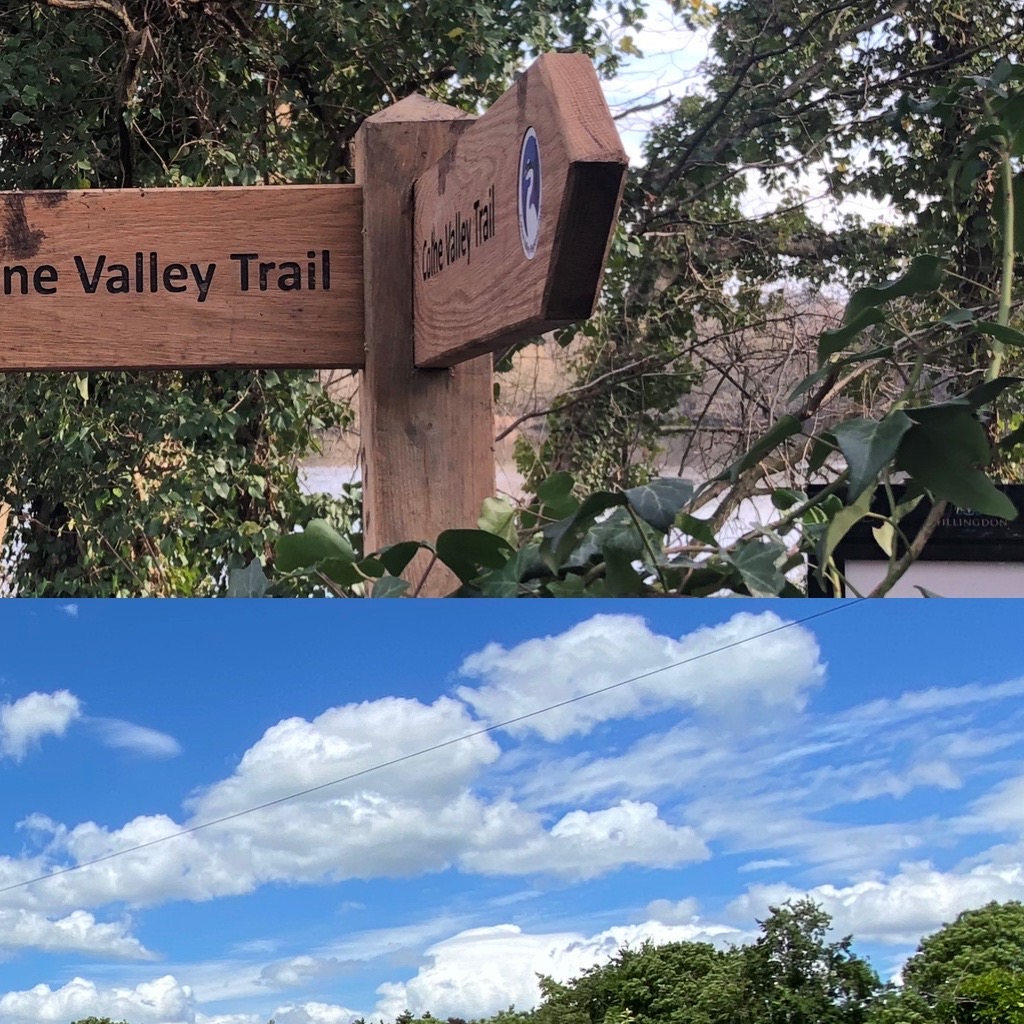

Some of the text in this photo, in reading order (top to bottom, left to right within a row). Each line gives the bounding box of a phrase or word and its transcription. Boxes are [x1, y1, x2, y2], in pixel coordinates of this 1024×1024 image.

[445, 211, 471, 266] Valley
[474, 184, 495, 248] Trail
[74, 251, 217, 303] Valley
[230, 248, 331, 292] Trail
